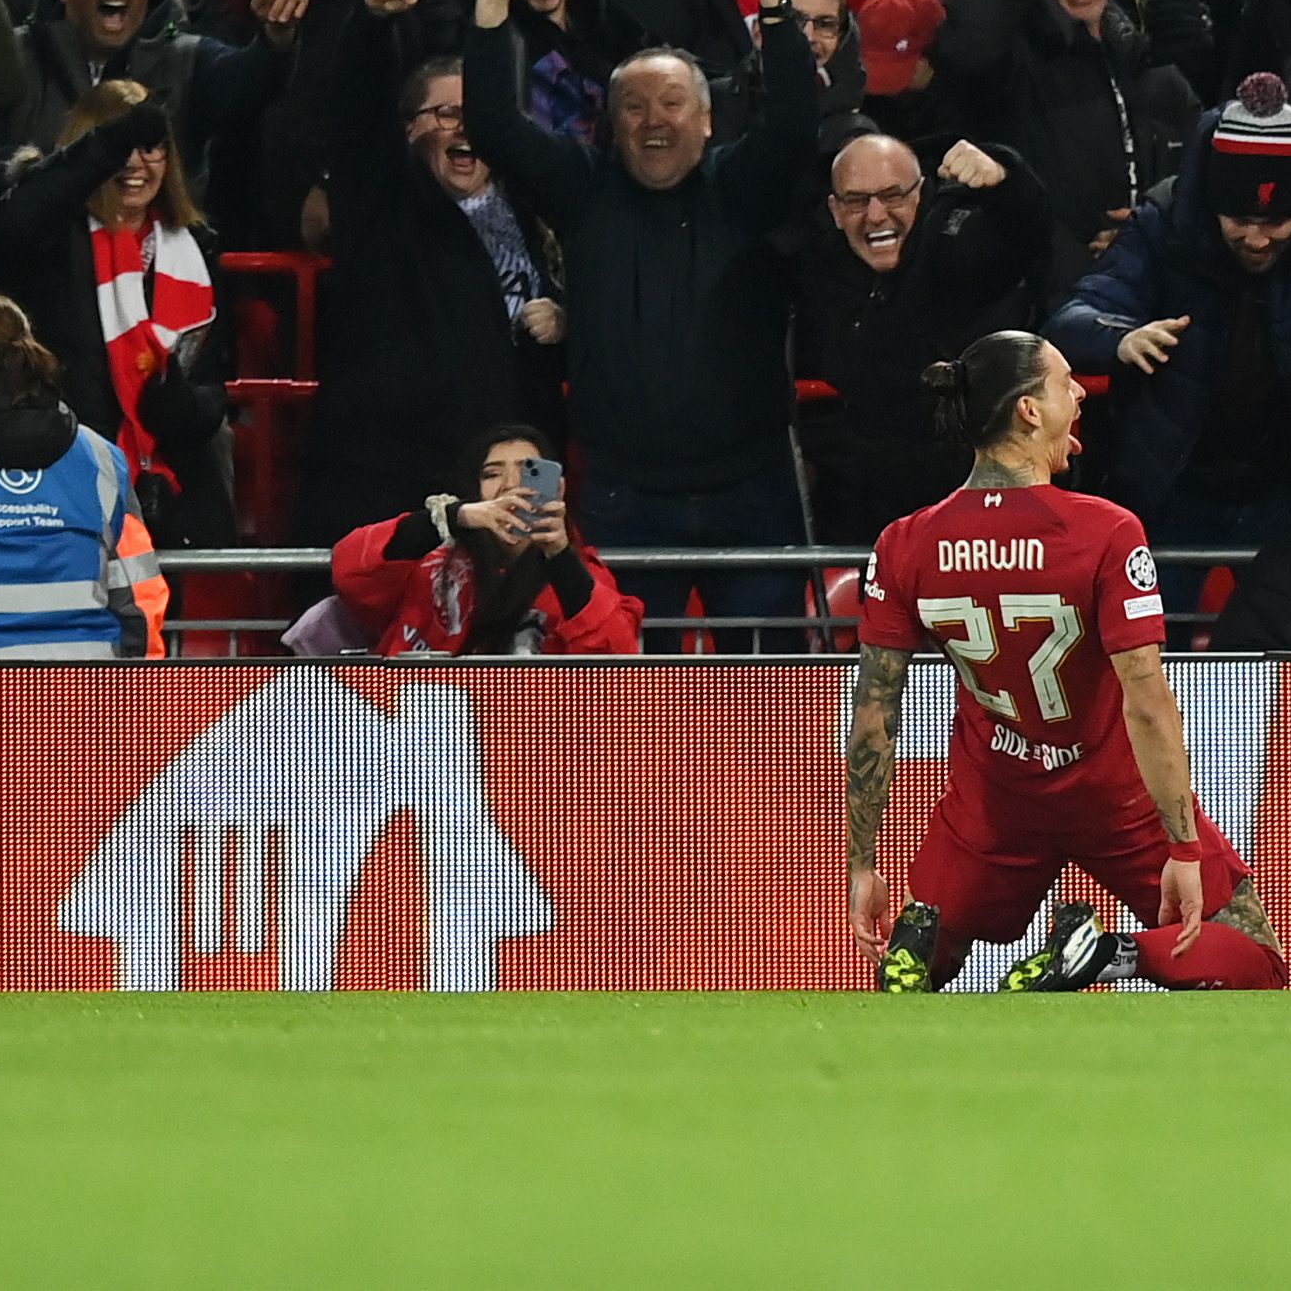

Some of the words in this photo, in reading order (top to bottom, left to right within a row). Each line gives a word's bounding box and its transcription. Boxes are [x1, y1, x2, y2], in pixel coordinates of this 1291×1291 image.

[32, 515, 65, 528] Team
[938, 539, 1045, 572] DARWIN
[917, 593, 1085, 724] 27
[990, 723, 1030, 761] SIDE
[1041, 742, 1084, 771] SIDE
